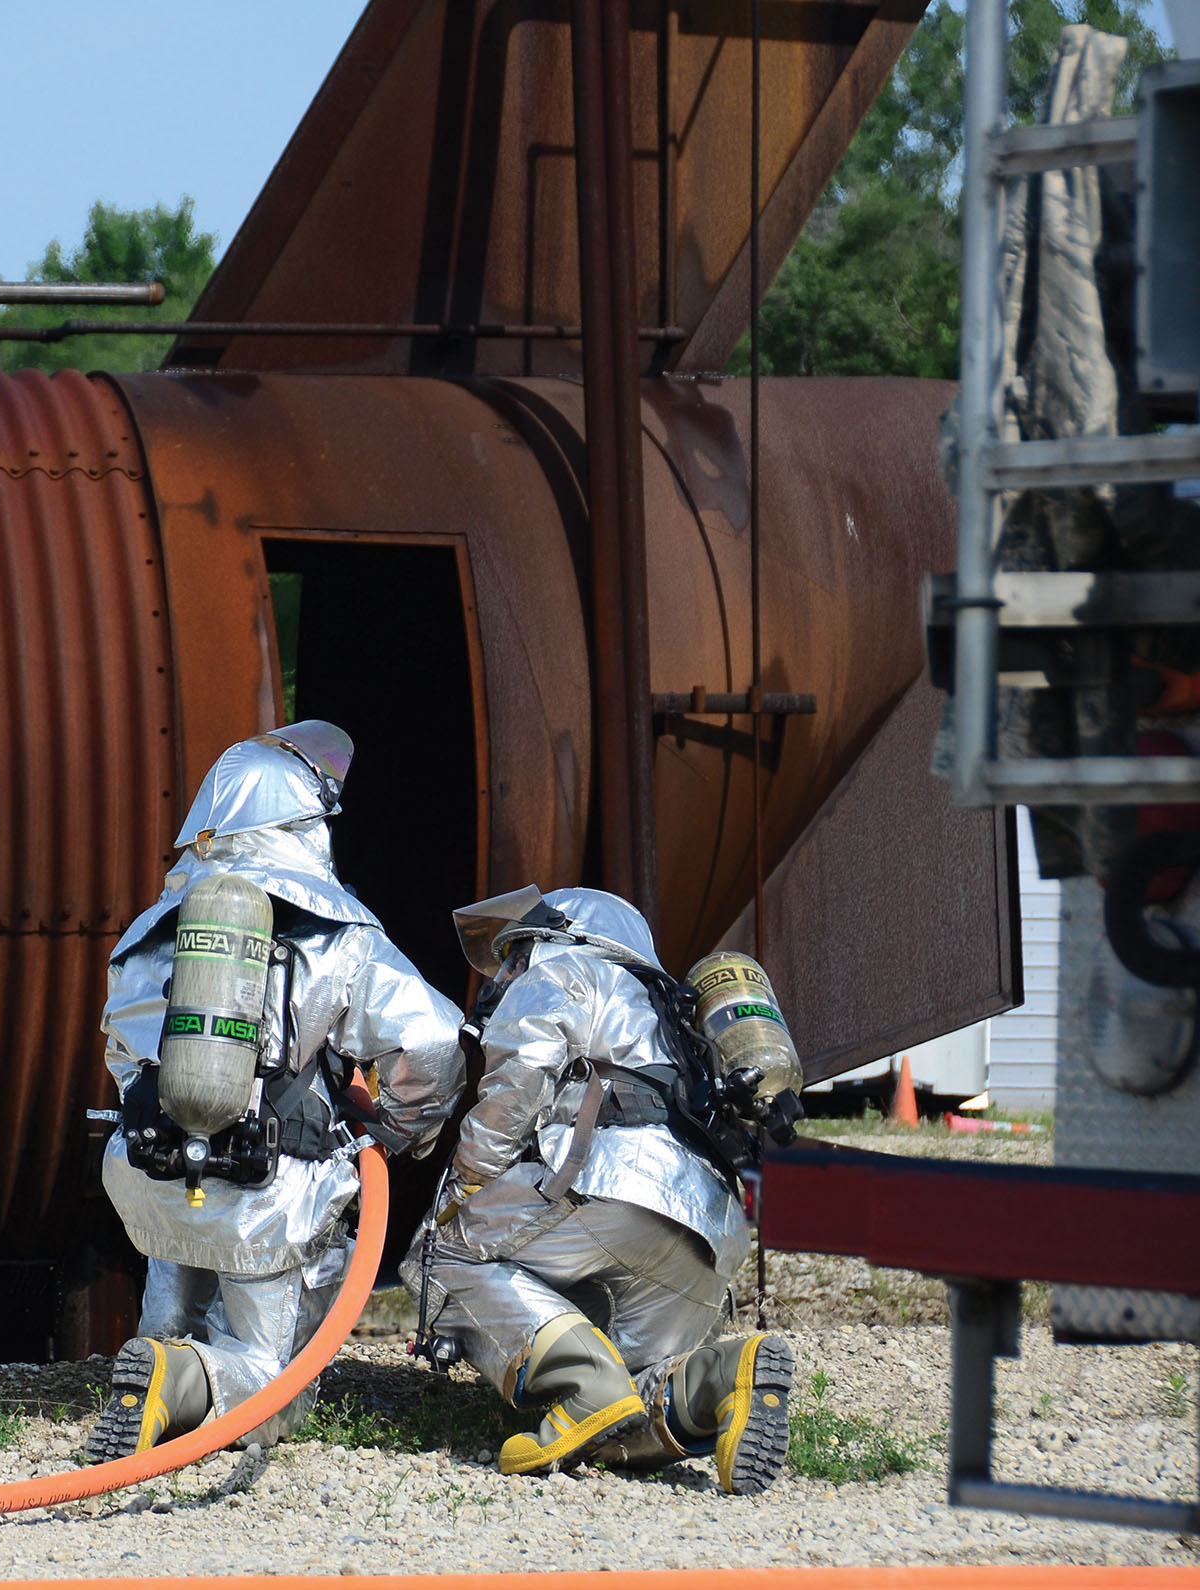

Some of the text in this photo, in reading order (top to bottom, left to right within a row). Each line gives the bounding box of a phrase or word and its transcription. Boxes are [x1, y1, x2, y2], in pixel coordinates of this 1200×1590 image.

[179, 932, 230, 952] MSA
[214, 1019, 257, 1042] MSA
[22, 1497, 43, 1511] PSI
